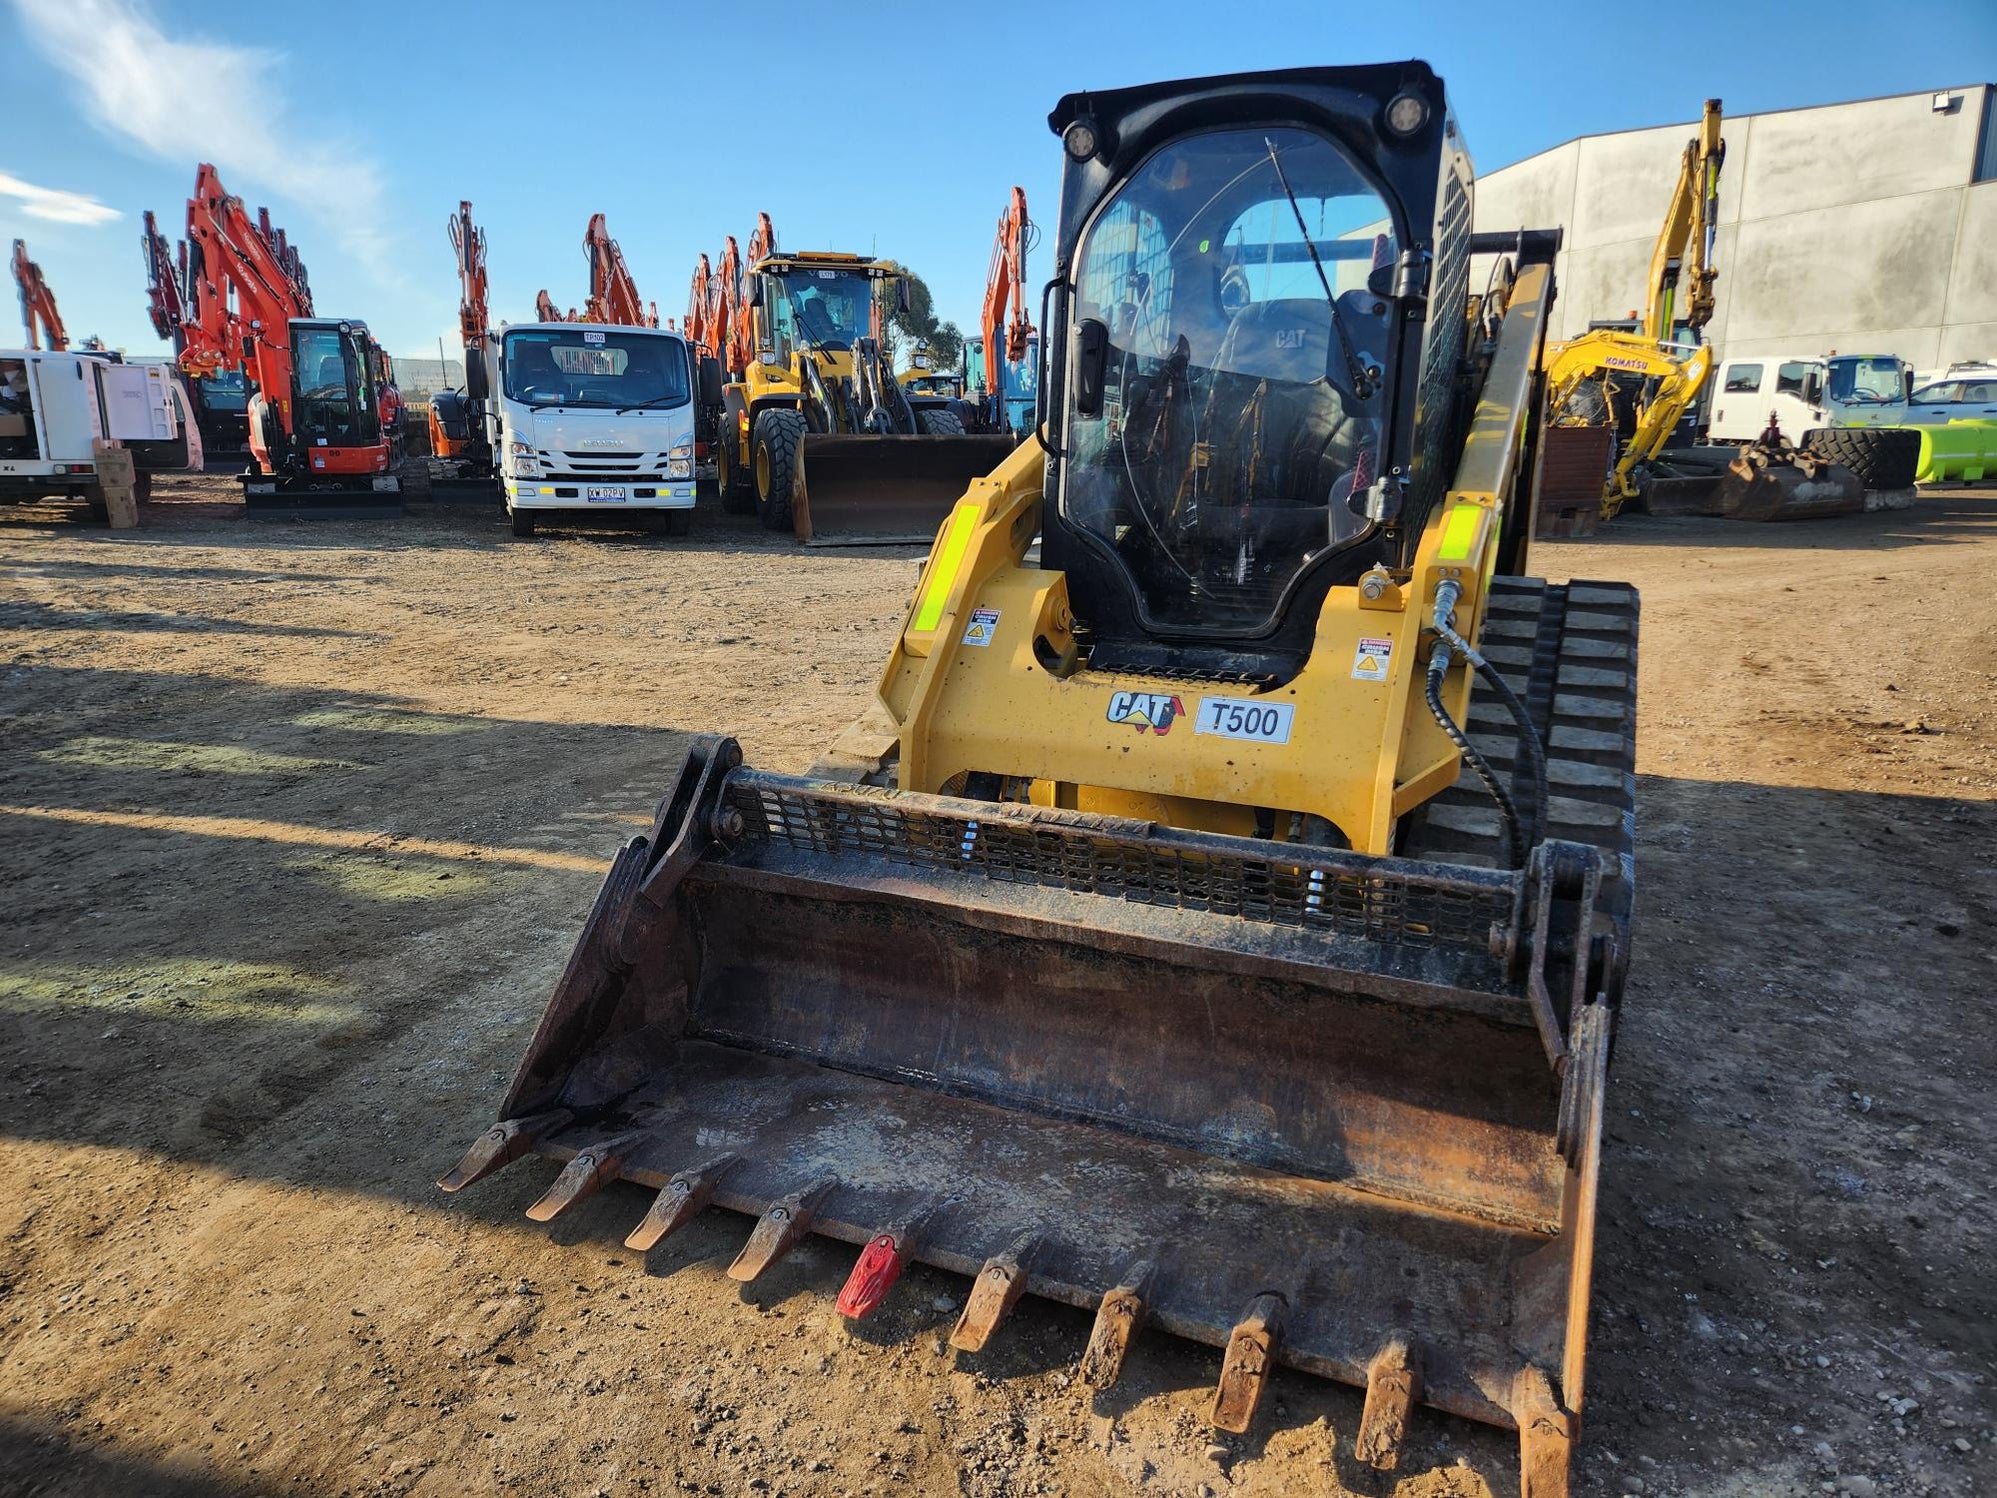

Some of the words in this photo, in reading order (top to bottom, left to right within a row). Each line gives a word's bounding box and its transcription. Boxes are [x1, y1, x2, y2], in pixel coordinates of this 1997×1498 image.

[1276, 329, 1306, 348] CAT
[1605, 356, 1649, 370] KOMATSU
[1107, 691, 1172, 727] CAT
[1211, 703, 1279, 736] T500
